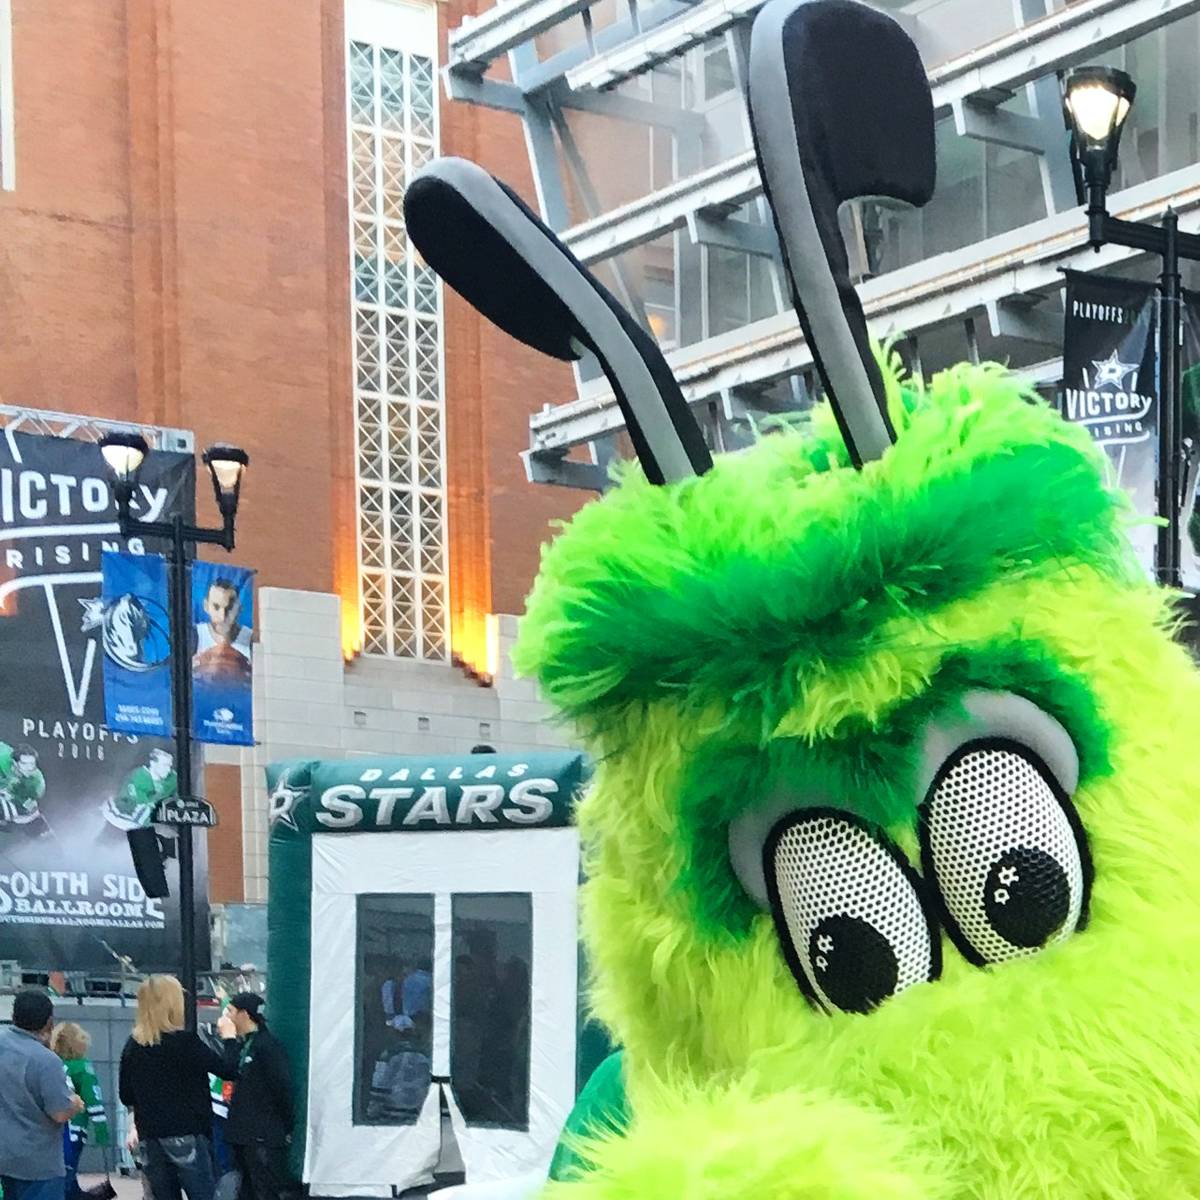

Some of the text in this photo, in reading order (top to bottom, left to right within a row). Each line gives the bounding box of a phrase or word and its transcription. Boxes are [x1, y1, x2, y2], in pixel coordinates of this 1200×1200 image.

[1073, 300, 1123, 324] PLAYOFFS
[1066, 388, 1152, 419] VICTORY
[1093, 421, 1143, 438] ISING
[0, 468, 168, 523] ICTOY
[359, 763, 529, 782] DALLAS
[315, 777, 560, 828] STARS
[167, 809, 210, 824] PLAZA
[15, 898, 144, 917] BALLROOM
